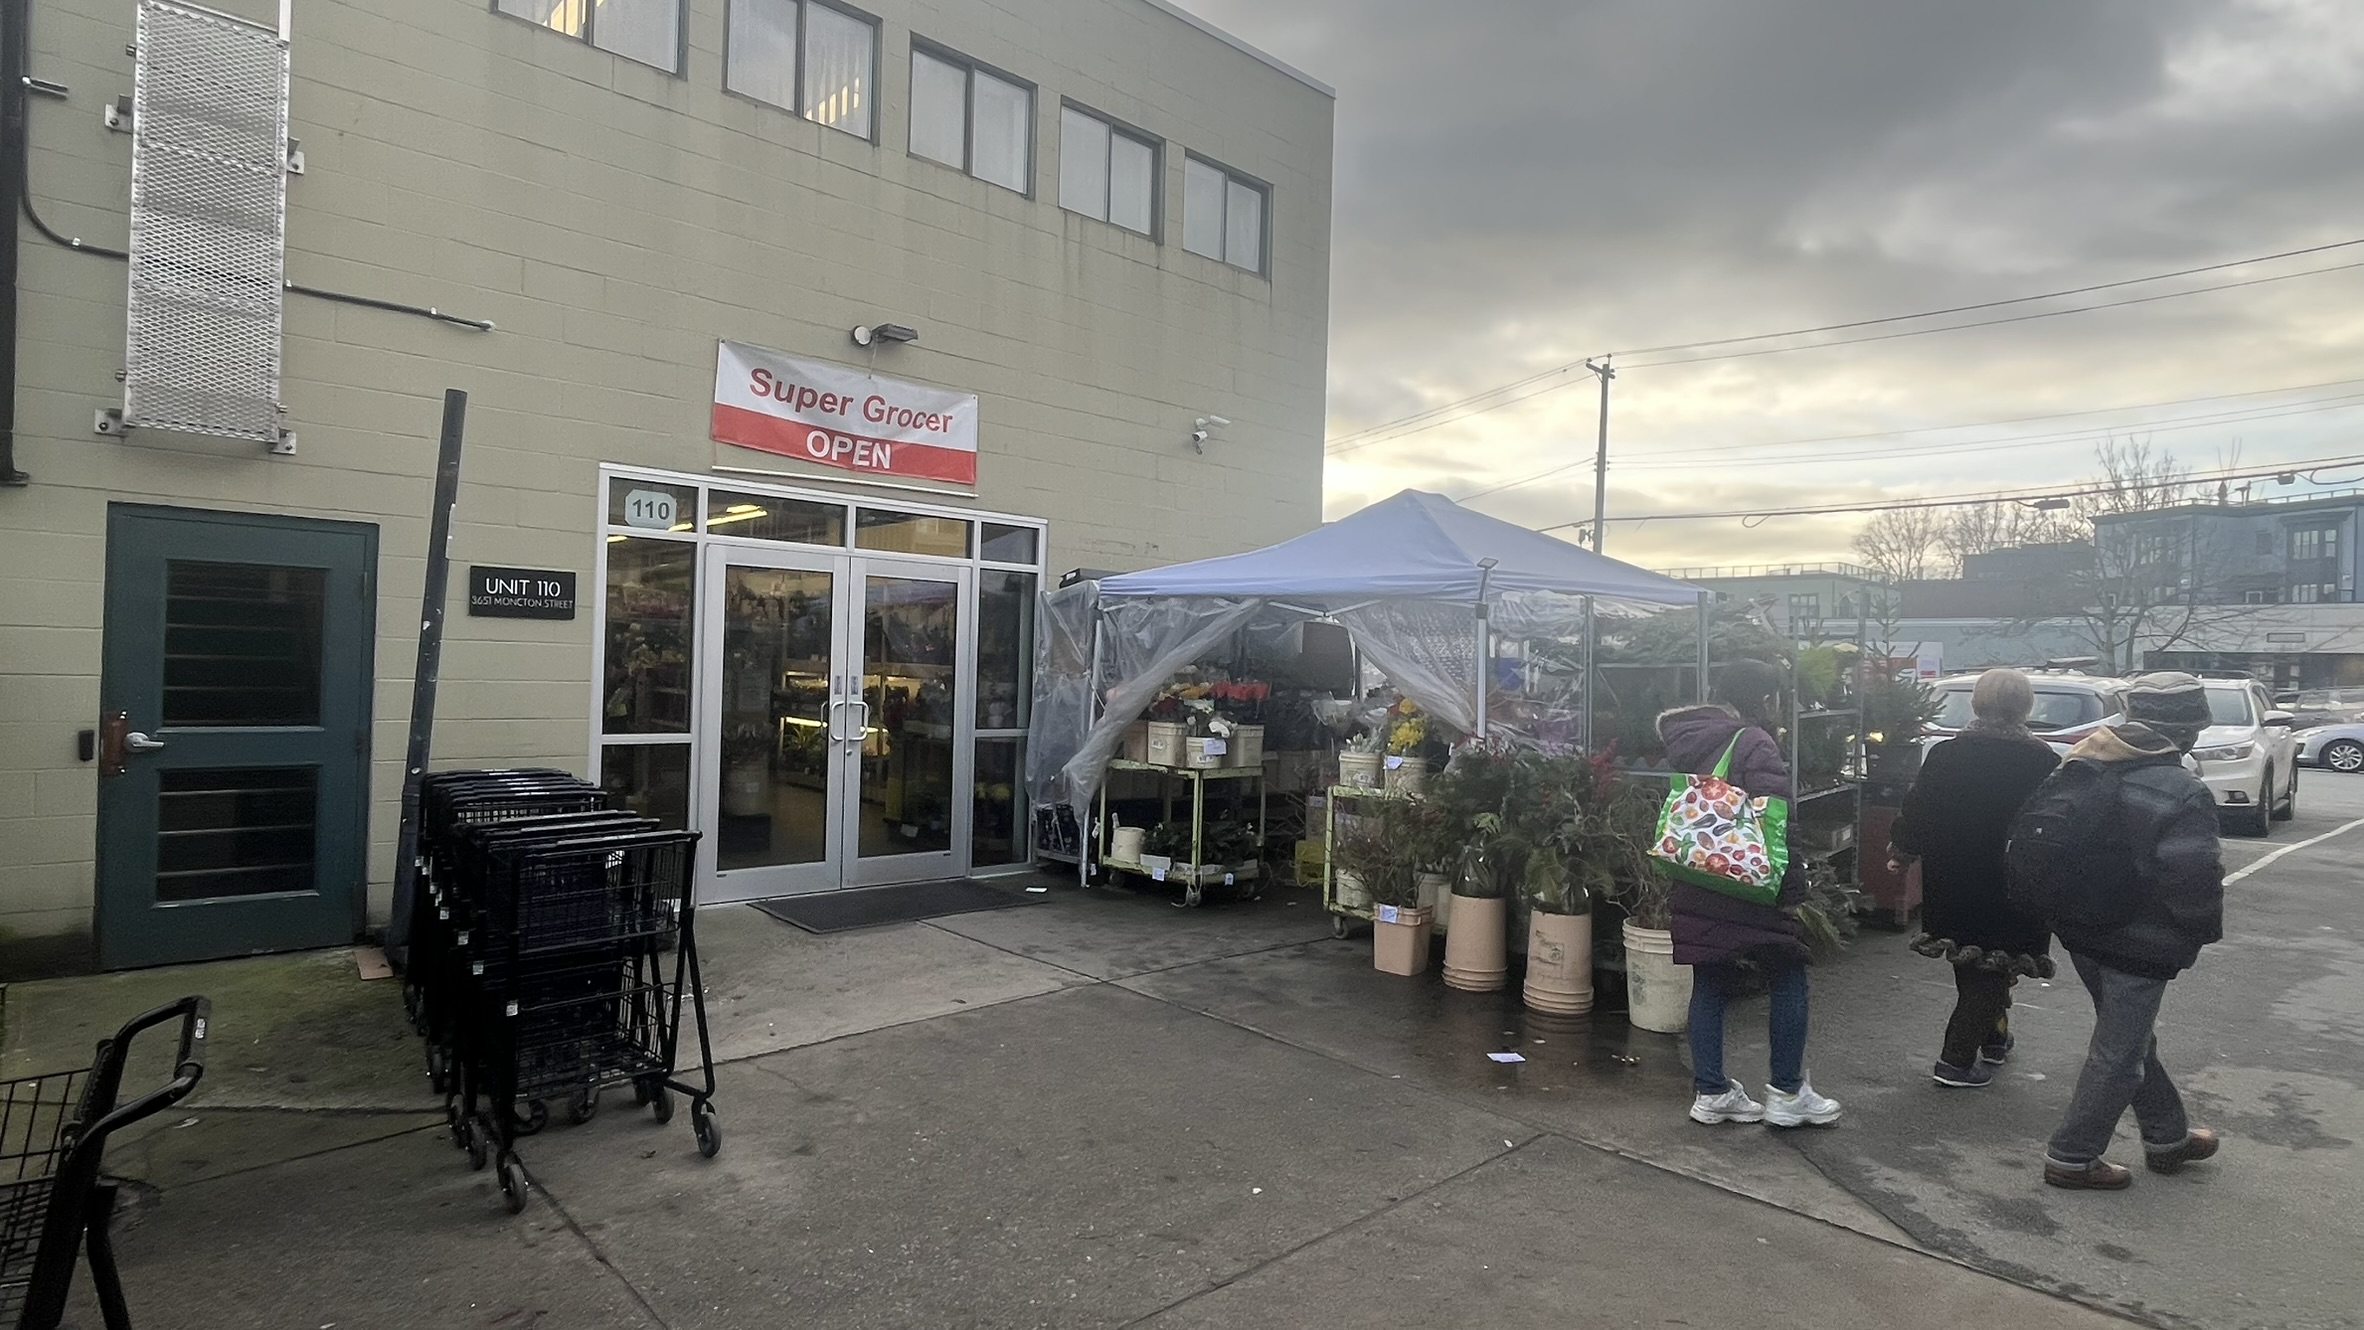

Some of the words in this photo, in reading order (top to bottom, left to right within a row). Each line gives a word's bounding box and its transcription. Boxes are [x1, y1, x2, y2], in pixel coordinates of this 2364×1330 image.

[750, 367, 854, 416] Super
[862, 395, 953, 432] Grocer
[806, 430, 891, 469] OPEN
[633, 498, 669, 520] 110
[486, 578, 530, 595] UNIT
[537, 580, 561, 597] 110
[471, 595, 492, 605] 3651
[494, 597, 541, 607] MONCTON
[544, 599, 573, 609] STREET
